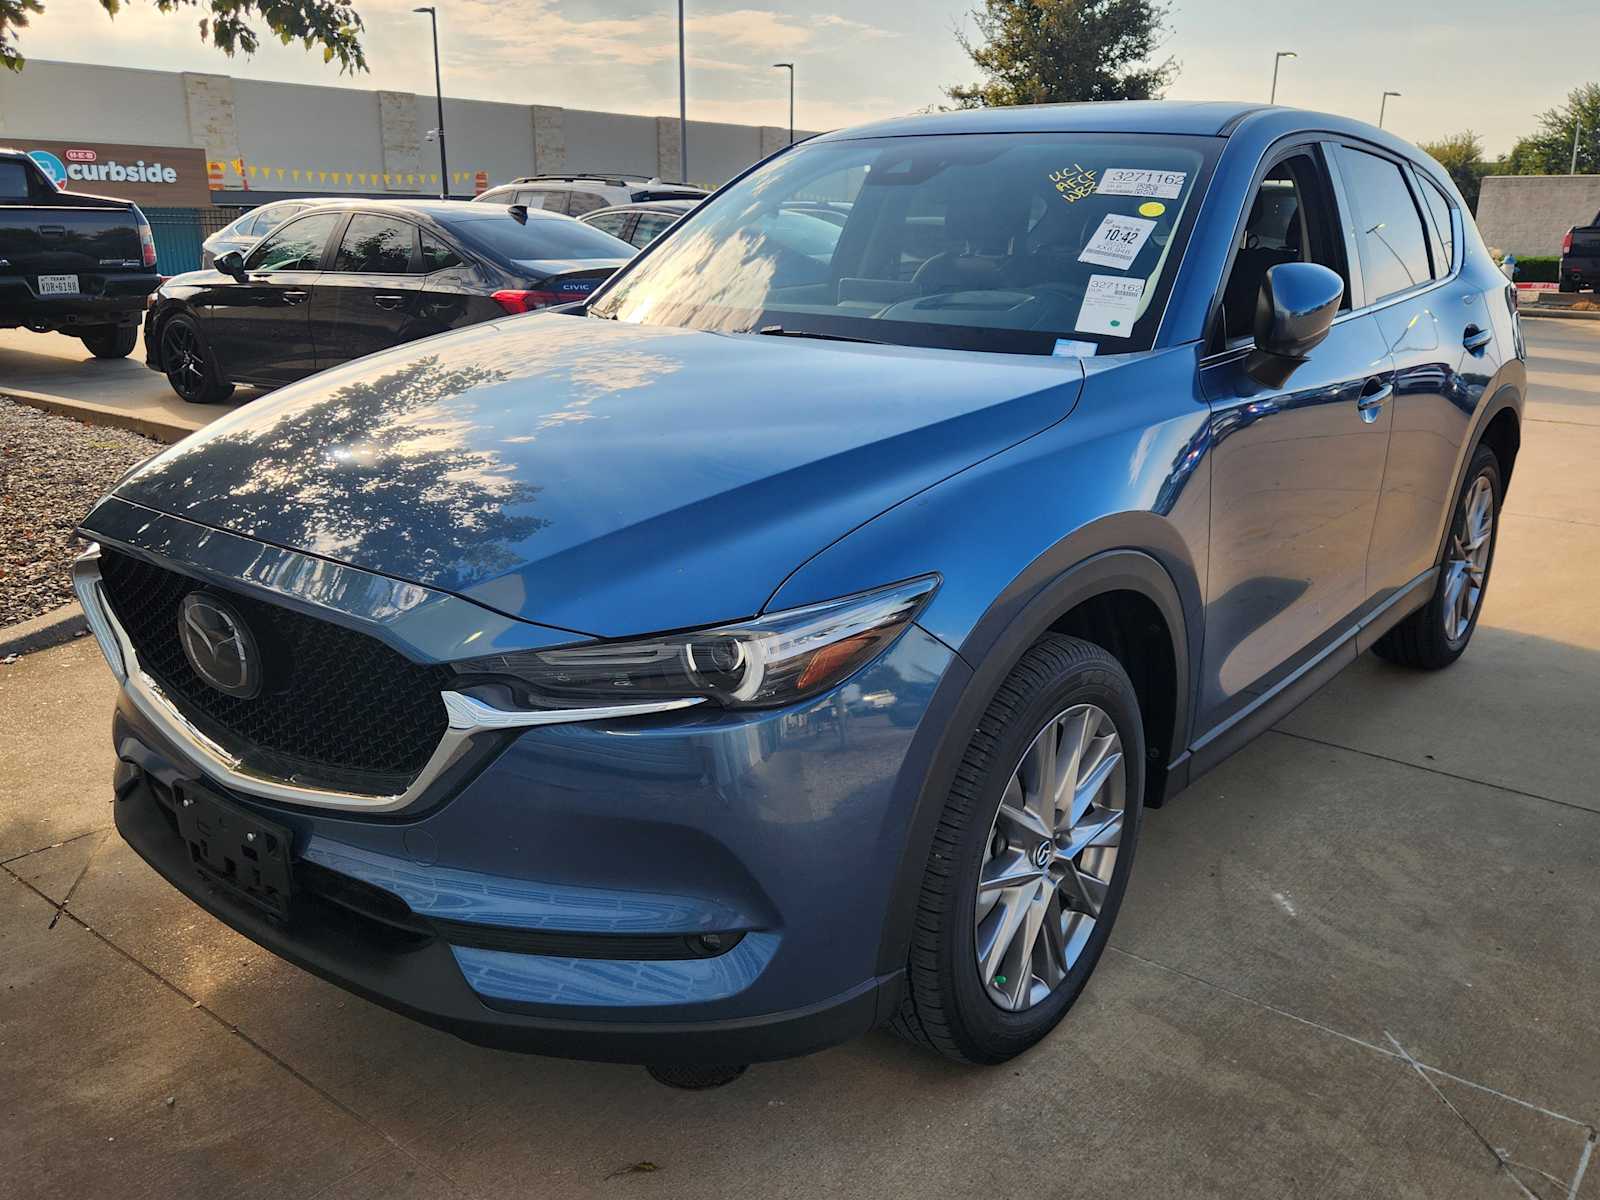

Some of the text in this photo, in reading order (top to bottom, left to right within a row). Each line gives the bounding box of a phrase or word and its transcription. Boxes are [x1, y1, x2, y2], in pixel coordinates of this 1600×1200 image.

[67, 160, 177, 183] curbside
[1112, 170, 1185, 185] 3271162
[1105, 229, 1138, 244] 10:42
[1091, 280, 1143, 292] 3271162
